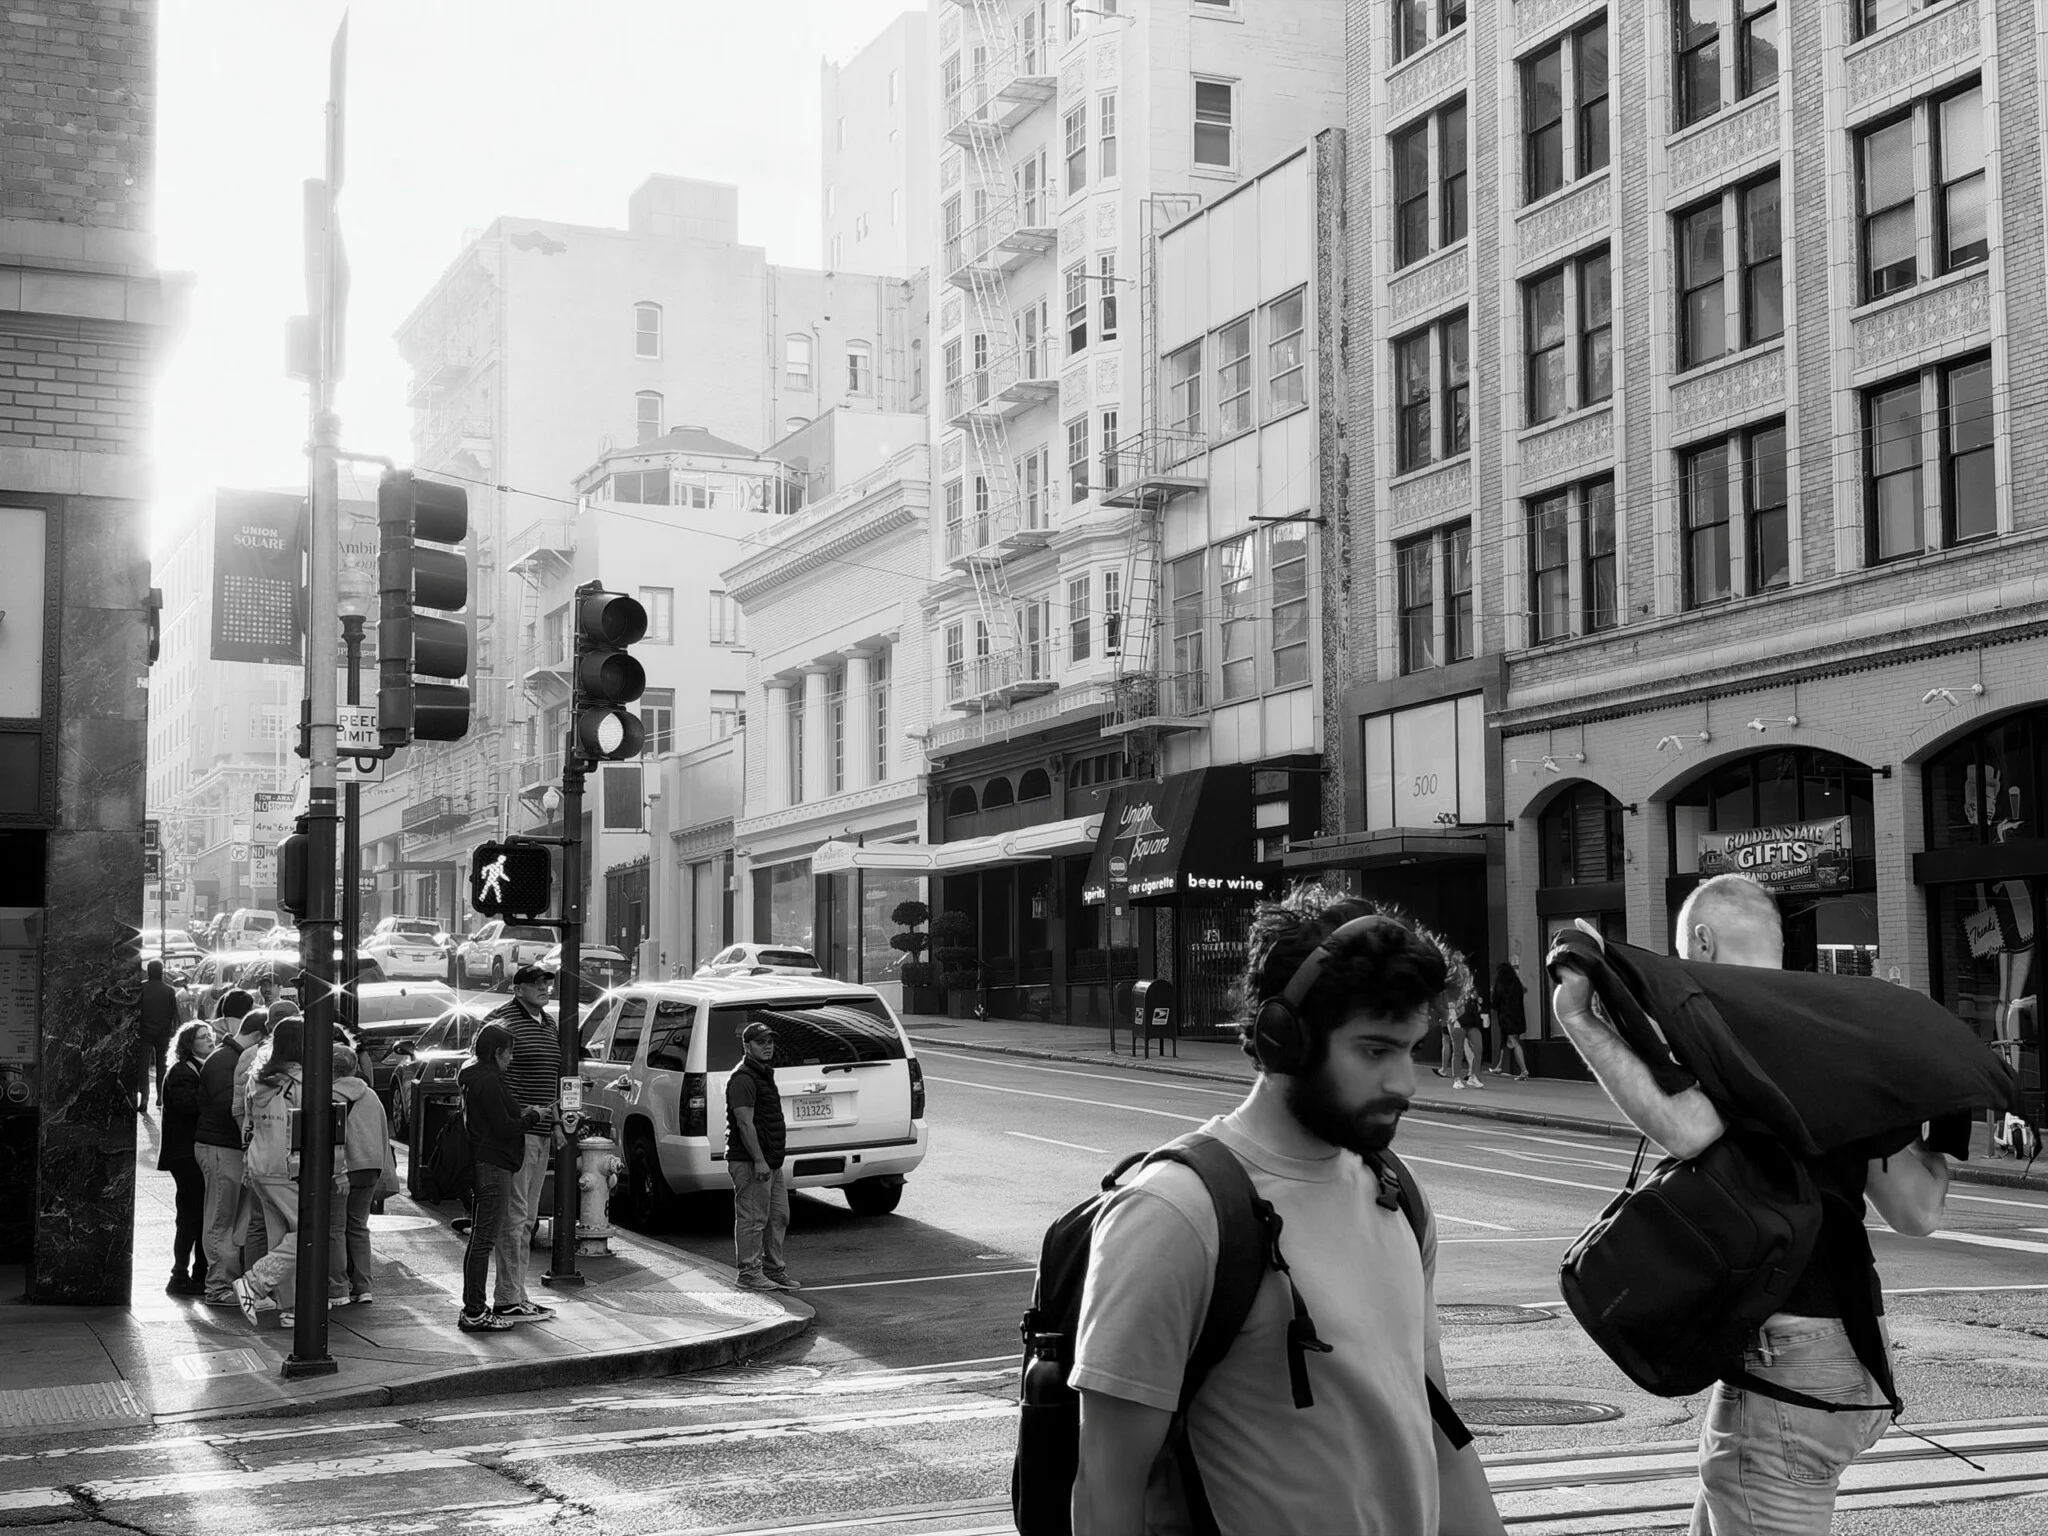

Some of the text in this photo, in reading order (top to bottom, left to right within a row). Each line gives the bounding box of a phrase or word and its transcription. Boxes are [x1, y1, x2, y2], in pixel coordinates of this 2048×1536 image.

[242, 525, 279, 537] UNION
[232, 533, 287, 551] SQUARE
[337, 730, 374, 742] IMIT
[1412, 773, 1438, 798] 500
[254, 801, 268, 812] NO
[1120, 802, 1154, 826] Union
[1436, 811, 1458, 825] 500
[1724, 825, 1825, 854] GOLDEN STATE
[250, 845, 265, 859] NO
[1130, 836, 1171, 863] Square
[1737, 841, 1809, 869] GIFTS
[1188, 872, 1264, 891] beer wine
[1770, 865, 1813, 882] OPENING!
[1084, 885, 1106, 904] spirits
[1141, 876, 1175, 895] cigarette
[796, 1104, 831, 1117] 1313225
